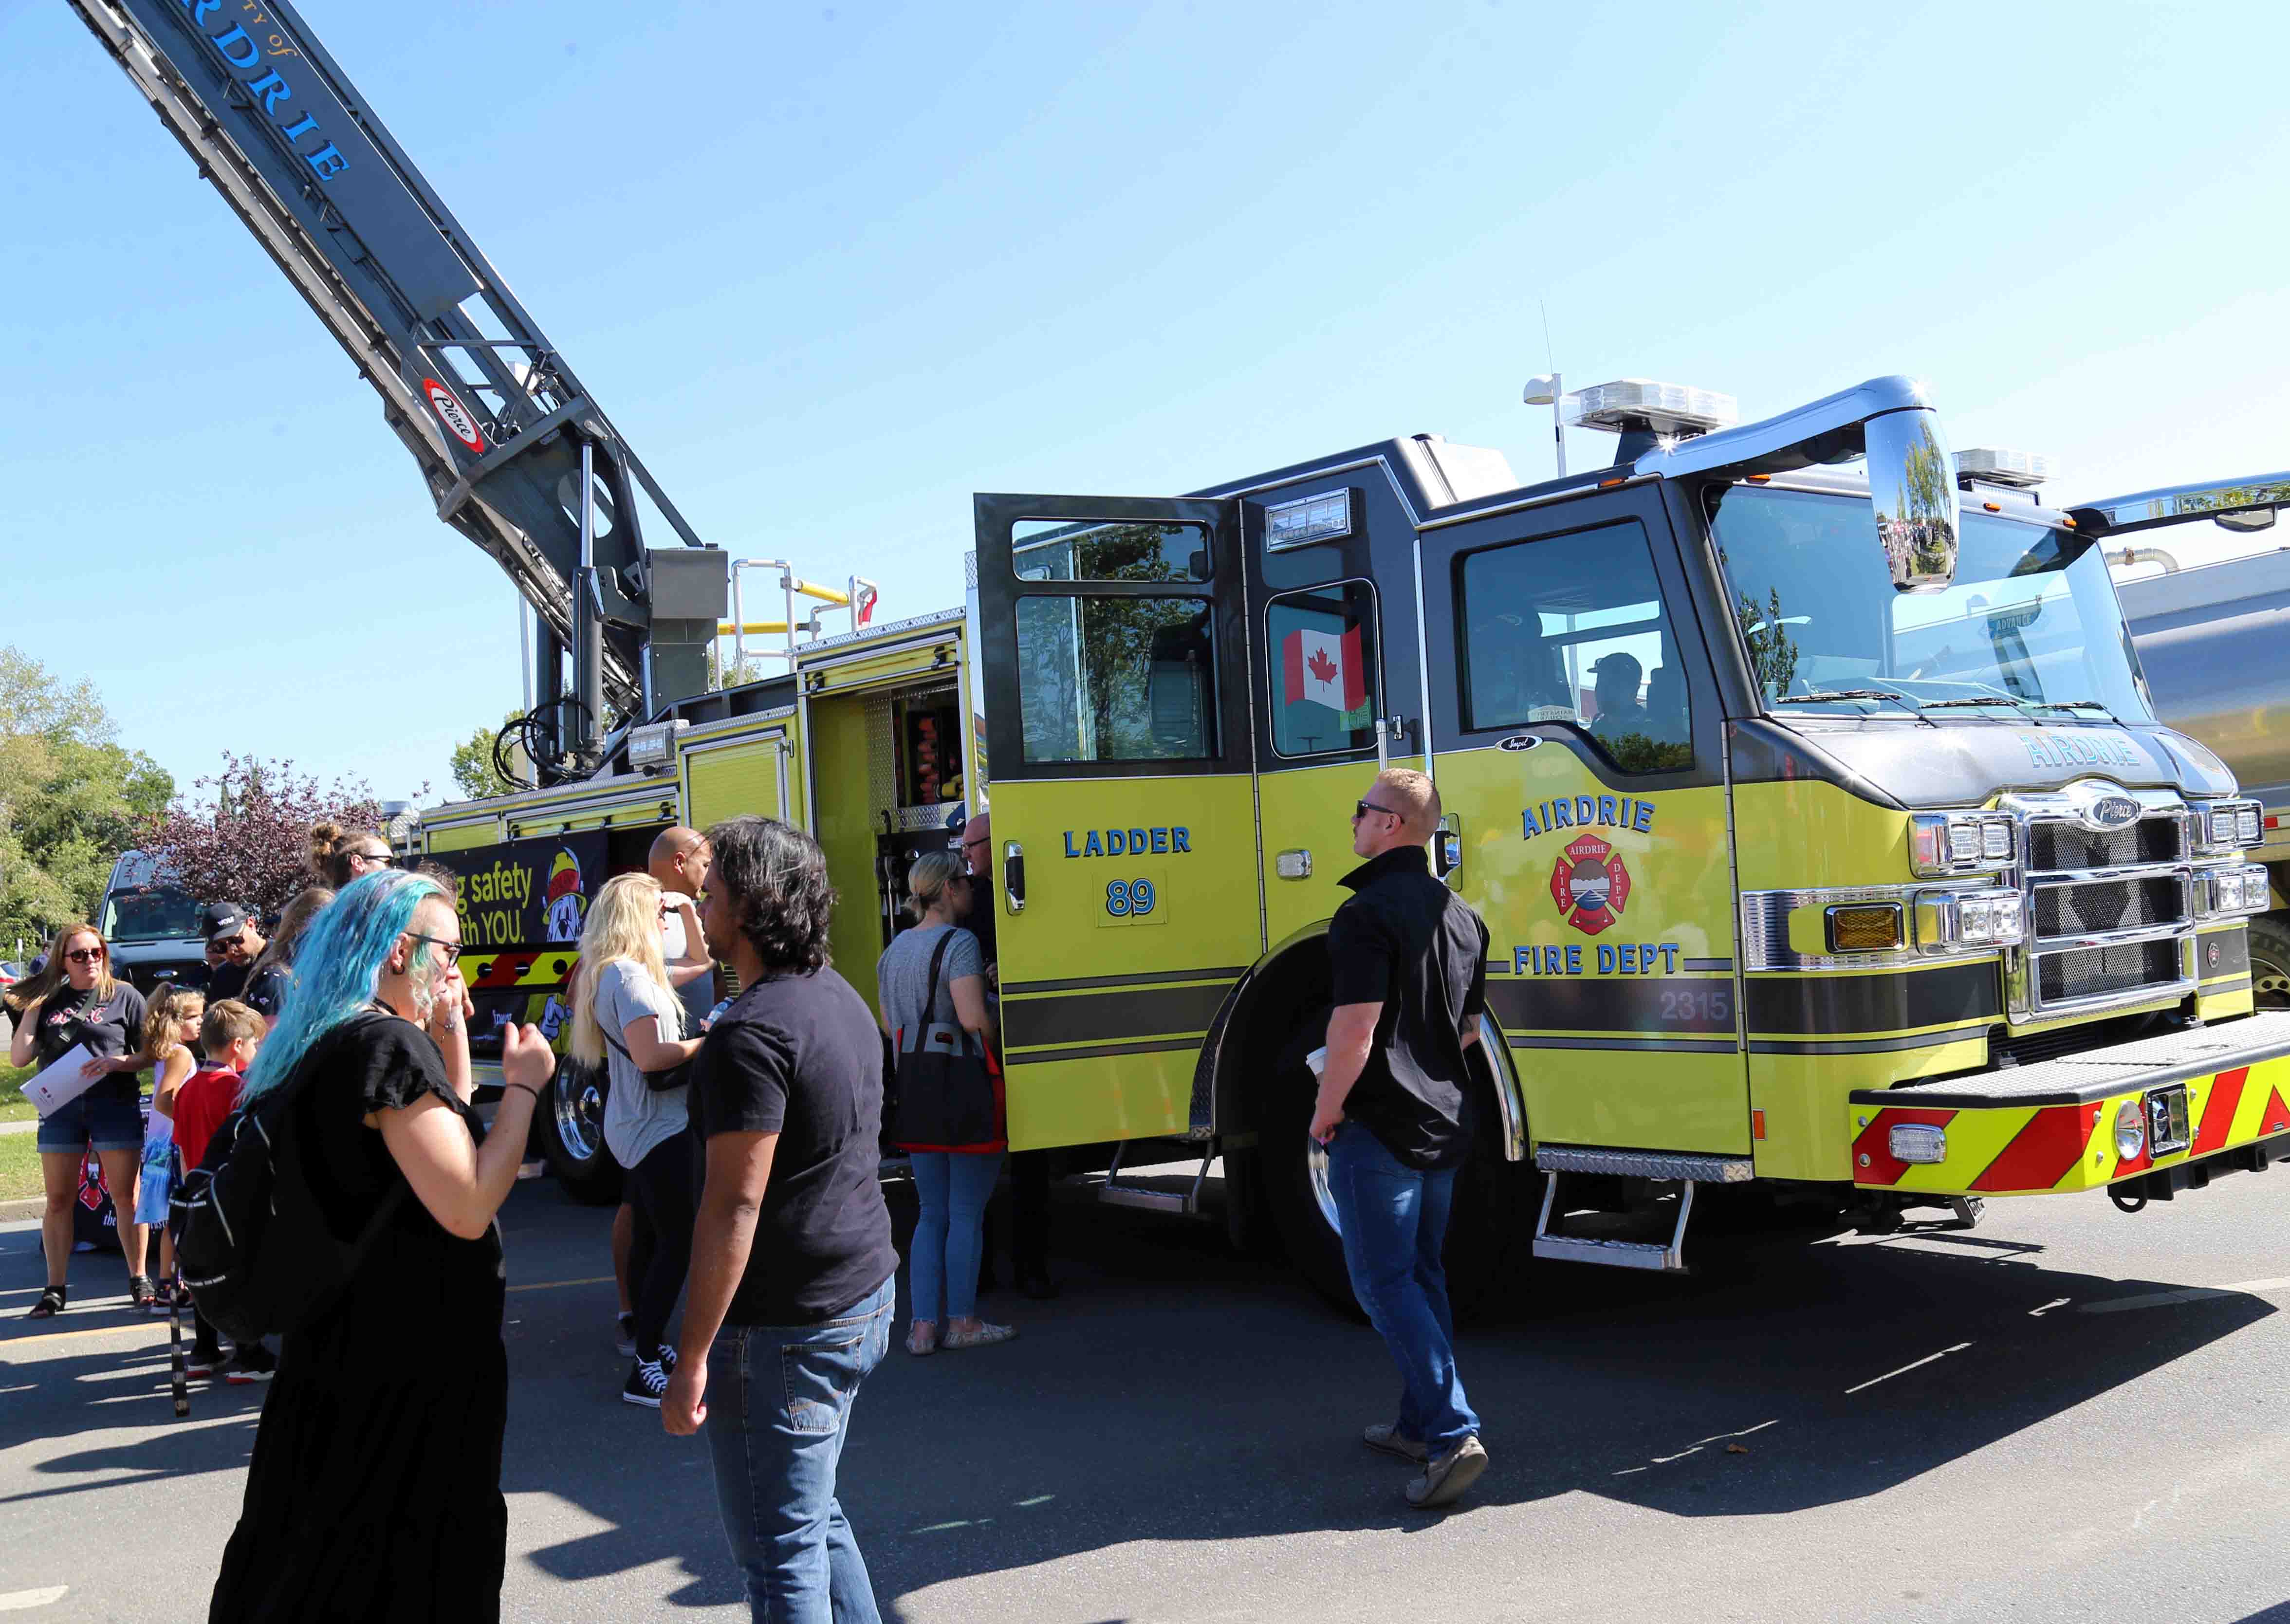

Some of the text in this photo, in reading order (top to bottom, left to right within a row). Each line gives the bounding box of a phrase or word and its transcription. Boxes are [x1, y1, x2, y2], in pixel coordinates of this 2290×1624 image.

[267, 35, 298, 57] of
[433, 395, 471, 437] Pierce
[1508, 737, 1529, 750] Impel
[2020, 736, 2140, 769] AIRDRIE
[1522, 794, 1656, 840] AIRDRIE
[2100, 800, 2133, 822] Pierce
[1064, 826, 1192, 858] LADDER
[1570, 844, 1607, 855] AIRDRIE
[471, 860, 532, 909] safety
[1106, 878, 1156, 918] 89
[1613, 864, 1624, 905] DEPT
[481, 909, 525, 945] YOU.
[1514, 943, 1680, 975] FIRE DEPT
[1661, 992, 1728, 1020] 2315
[103, 1210, 116, 1226] the
